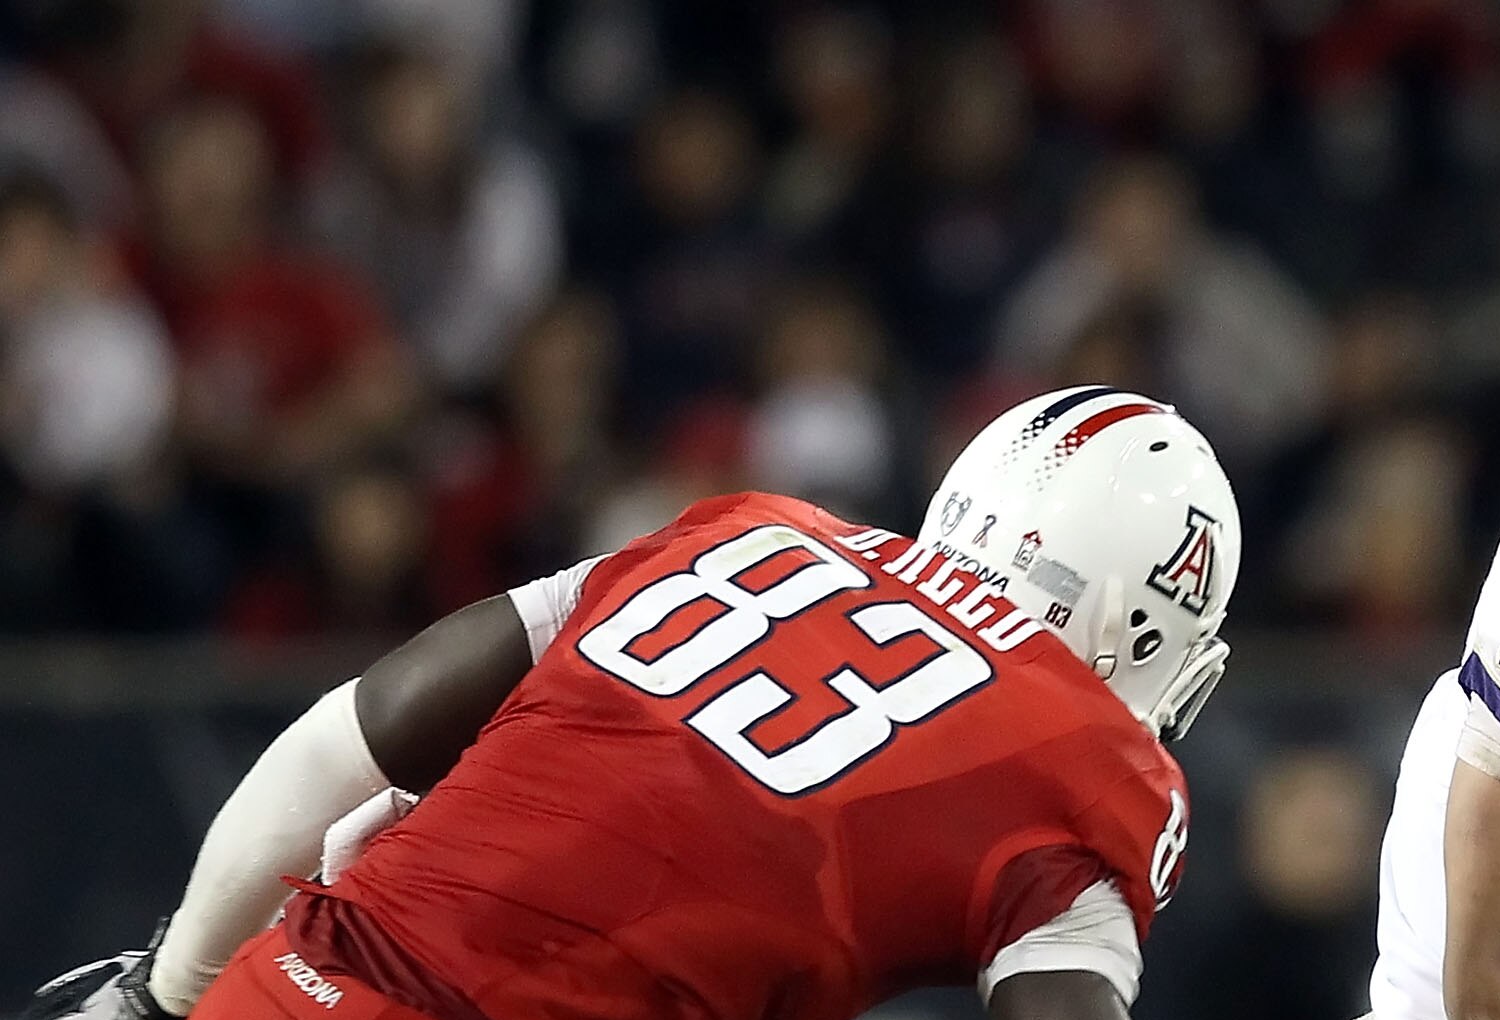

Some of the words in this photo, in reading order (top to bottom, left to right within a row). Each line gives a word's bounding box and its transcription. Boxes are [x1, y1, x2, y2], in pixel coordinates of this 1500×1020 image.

[1145, 504, 1223, 618] A
[1044, 601, 1074, 630] 83
[576, 522, 998, 799] 83
[273, 952, 345, 1009] ARIZONA
